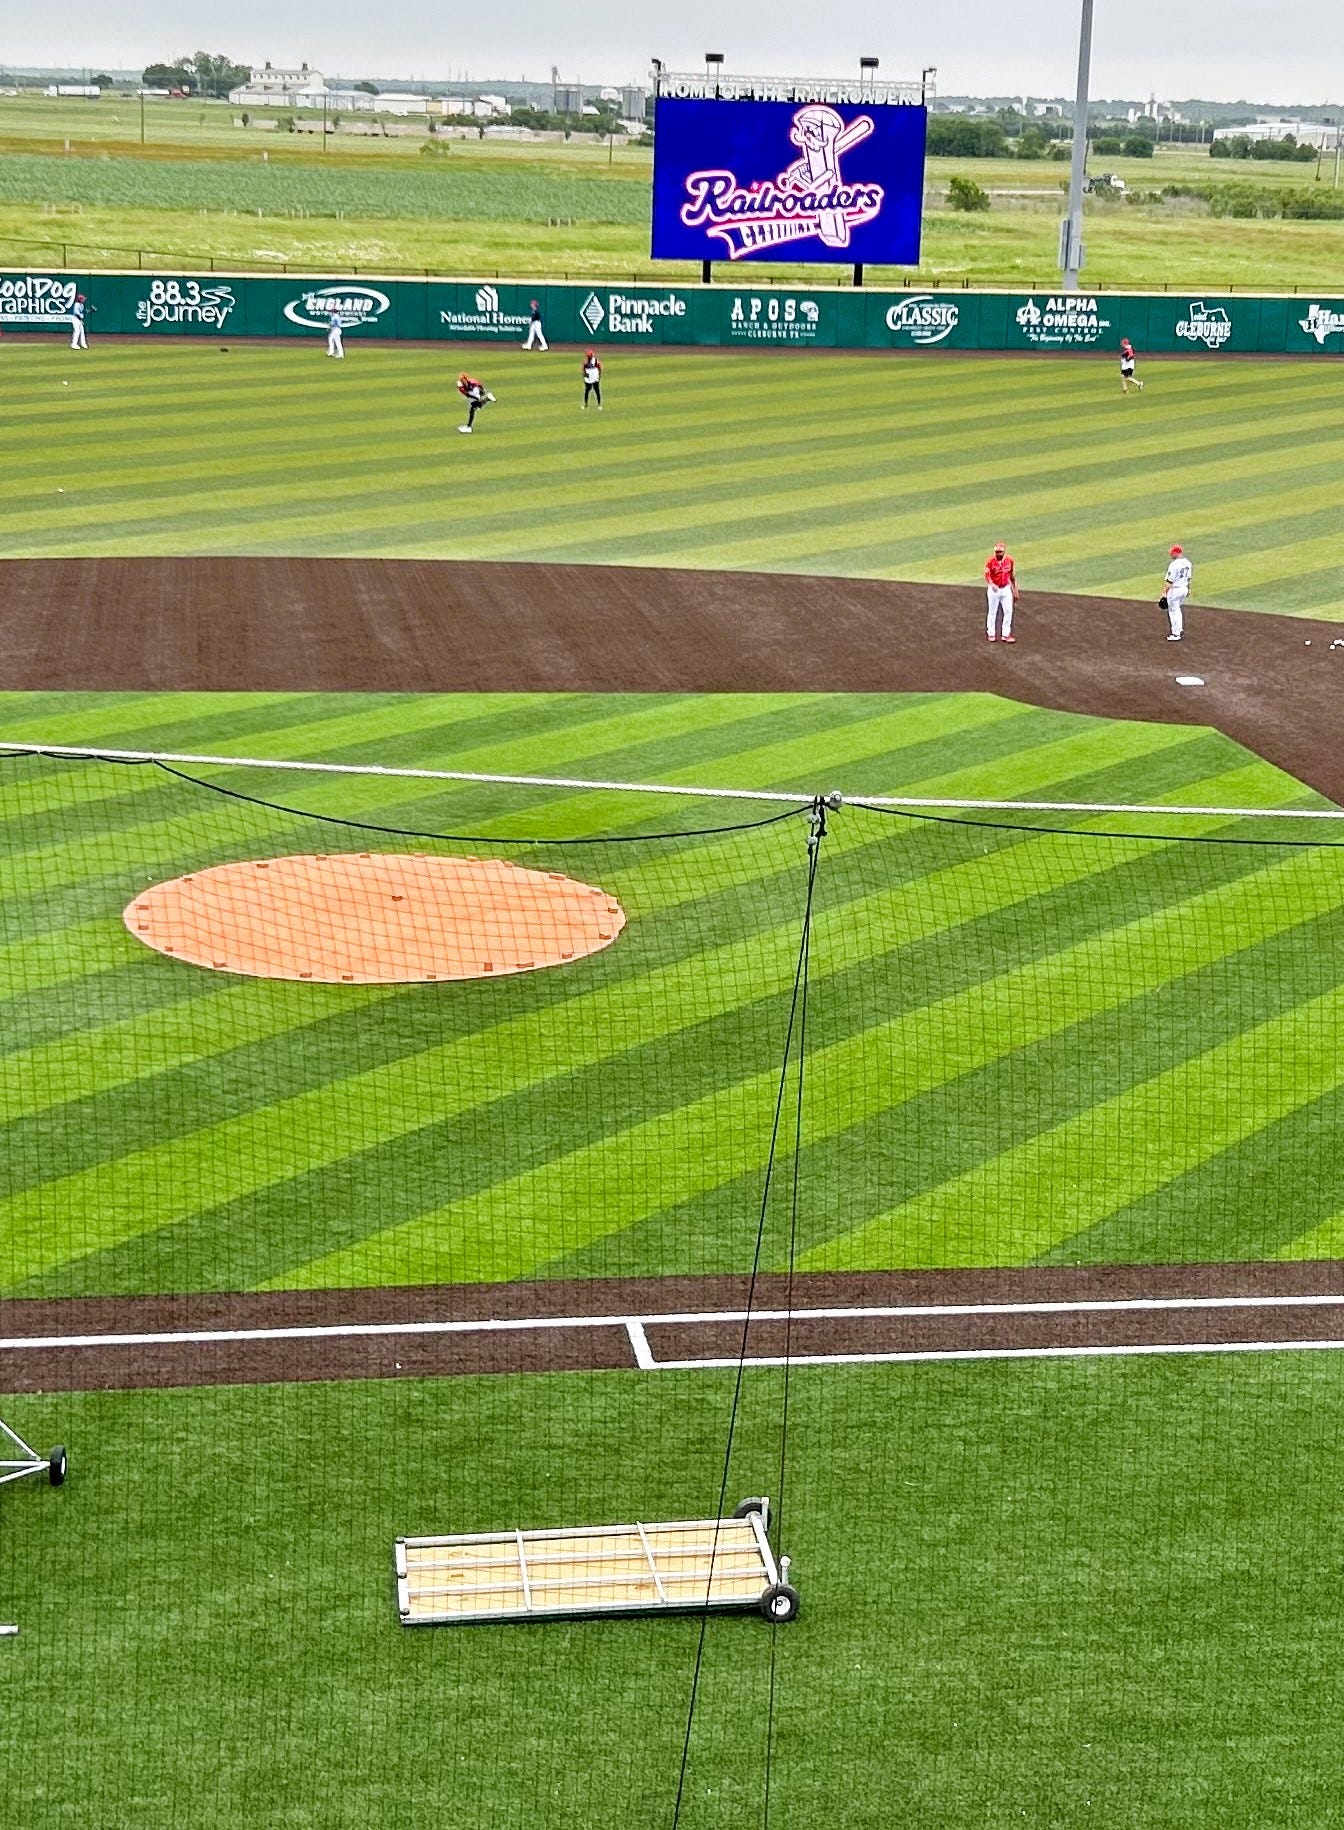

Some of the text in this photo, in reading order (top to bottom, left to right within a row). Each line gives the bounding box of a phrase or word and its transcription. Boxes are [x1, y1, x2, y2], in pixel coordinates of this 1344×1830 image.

[659, 81, 923, 106] HOME OF THE RAILROADERS
[681, 172, 884, 224] Railroaders
[150, 280, 201, 305] 88.3
[136, 301, 147, 320] the
[142, 300, 229, 329] Journey
[306, 297, 374, 312] ENGLAND
[609, 294, 687, 316] Pinnacle
[731, 298, 796, 321] APOS
[1046, 298, 1098, 311] ALPHA
[440, 311, 491, 324] National
[609, 313, 653, 333] Bank
[886, 305, 959, 331] CLASSIC
[1042, 313, 1098, 327] OMEGA
[1176, 320, 1232, 337] CLEBURNE
